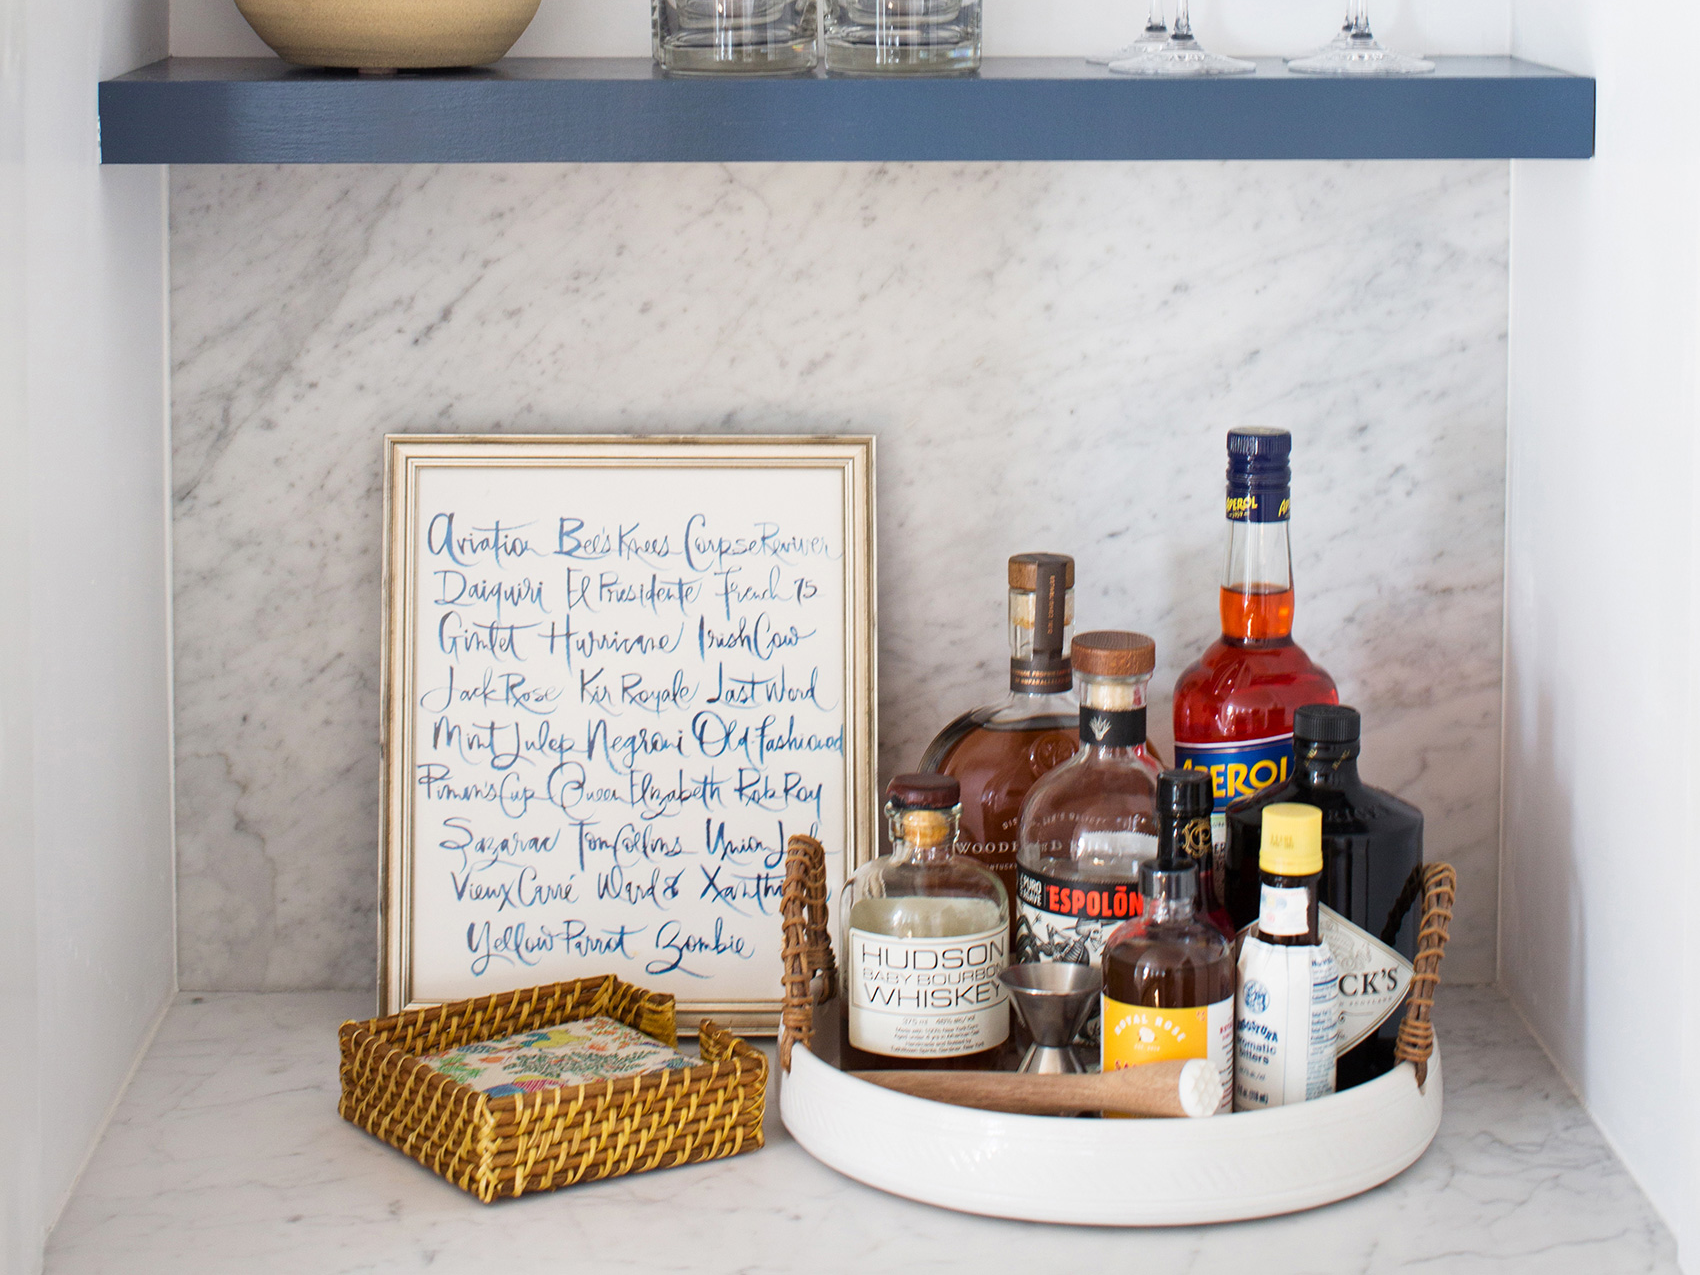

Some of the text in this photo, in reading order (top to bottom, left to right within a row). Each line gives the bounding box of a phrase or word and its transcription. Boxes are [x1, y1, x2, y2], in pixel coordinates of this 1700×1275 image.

[428, 512, 549, 569] Aviation
[618, 522, 682, 570] Knees
[685, 513, 761, 572] Corpse
[755, 522, 842, 565] Reviver
[434, 565, 820, 620] Daiquiri El Presidente French 75
[439, 611, 817, 677] Gimlet Hurricane Irish Cow
[420, 661, 838, 719] Jack Rose Kir Royale Last Word
[433, 715, 511, 765] Mint
[491, 720, 580, 775] Julep
[587, 718, 691, 775] Negroni
[500, 771, 540, 819] Cup
[548, 761, 621, 821] Queen
[630, 765, 731, 821] Elizabeth
[734, 767, 782, 811] Rob
[784, 772, 824, 824] Roy
[1183, 755, 1288, 798] EROL
[568, 819, 614, 872] Tom
[613, 822, 690, 869] Collins
[706, 818, 771, 866] Union
[450, 863, 518, 913] Vieux
[518, 865, 579, 908] Carré
[598, 864, 669, 912] Ward
[467, 916, 755, 978] Yellow Parrot Zombie
[862, 936, 1005, 970] HUDSON
[863, 963, 1004, 987] BABY BOURBON
[864, 979, 1001, 1009] WHISKEY
[1114, 1014, 1186, 1042] ROYAL ROSE
